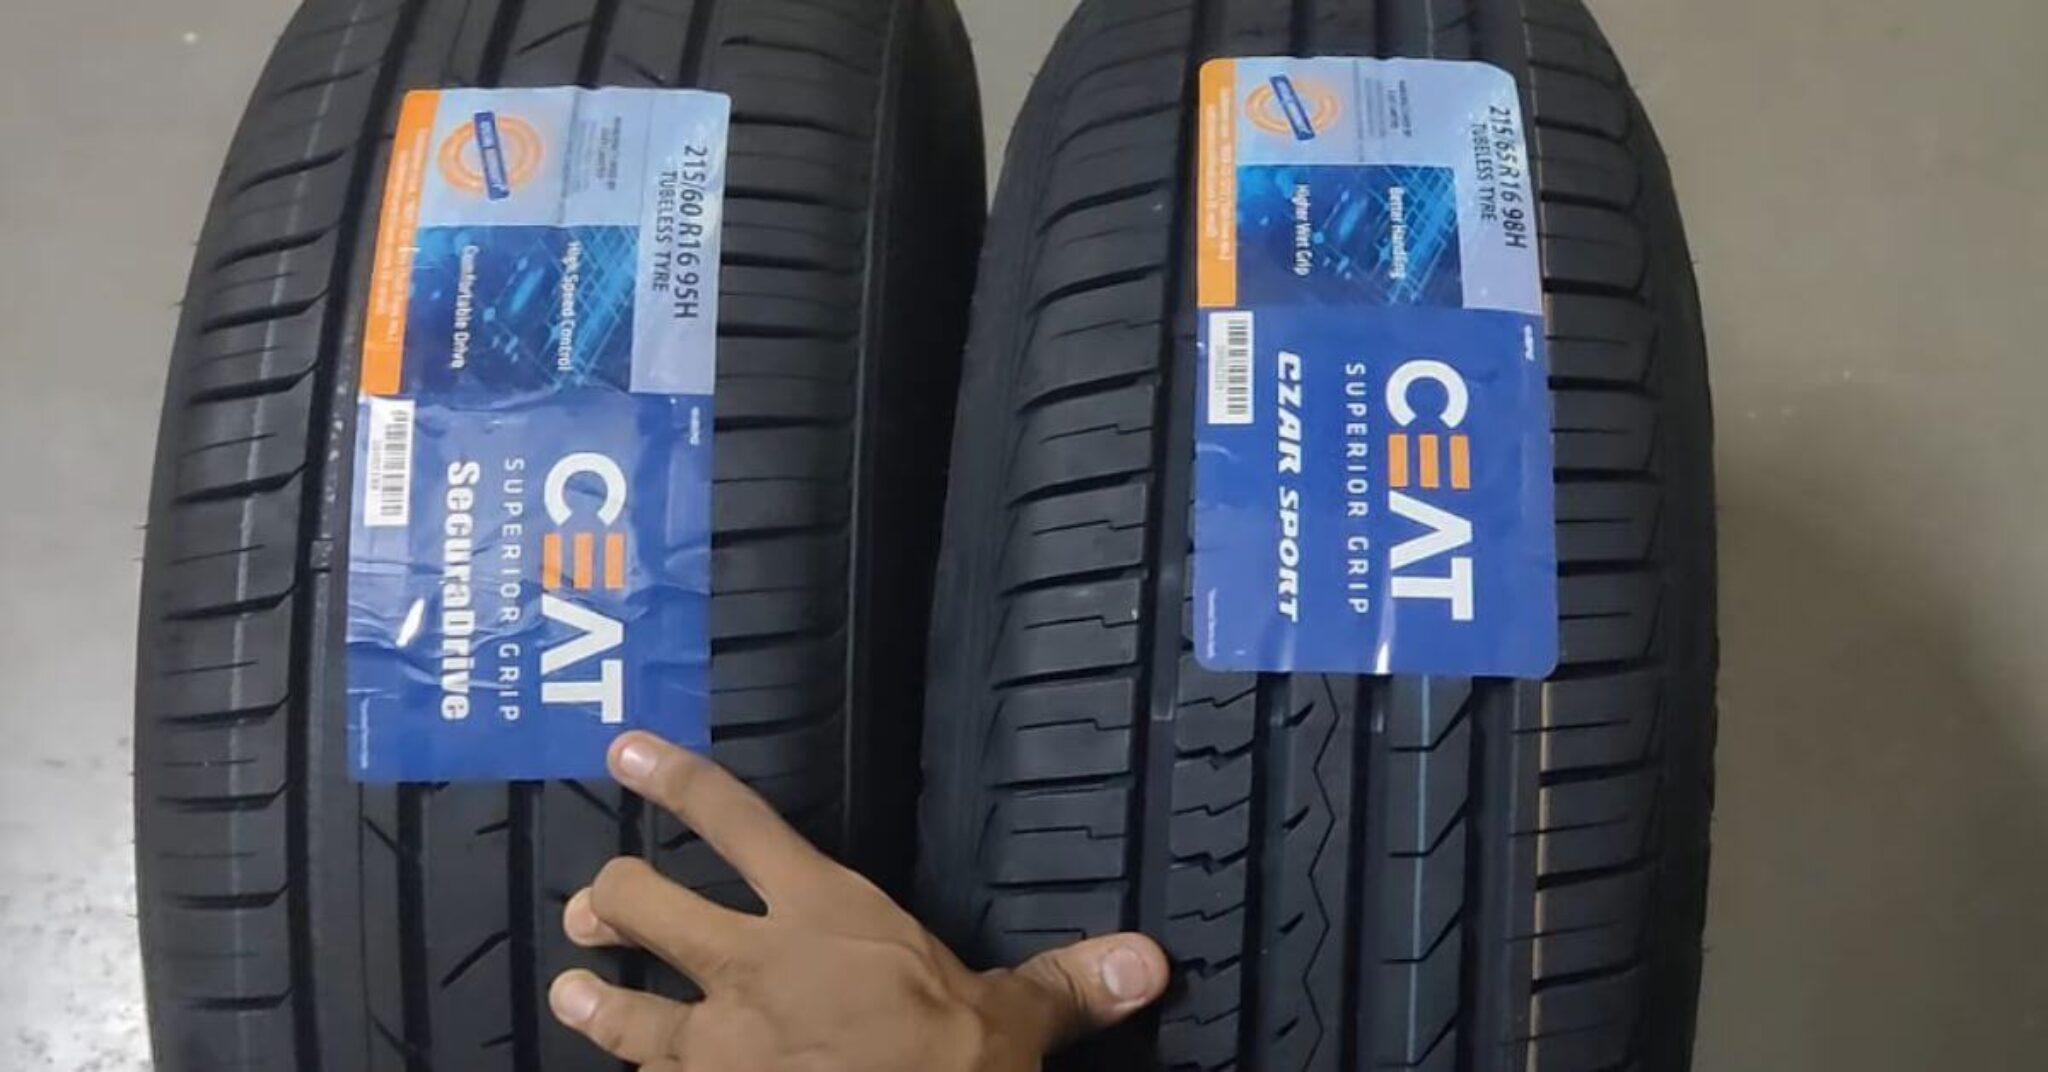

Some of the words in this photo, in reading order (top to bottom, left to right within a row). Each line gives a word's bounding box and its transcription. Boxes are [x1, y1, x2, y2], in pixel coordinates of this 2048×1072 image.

[678, 145, 708, 217] 215/60
[1470, 123, 1493, 182] TUBELESS
[654, 170, 678, 243] TUBELESS
[1290, 184, 1310, 221] Higher
[1477, 186, 1497, 222] TYRE
[1501, 207, 1528, 249] 98H
[560, 240, 581, 273] High
[651, 251, 671, 292] TYRE
[676, 223, 702, 267] R16
[1291, 250, 1313, 276] Grip
[1387, 224, 1407, 280] Handling
[454, 245, 480, 328] Comfortable
[559, 274, 579, 317] Speed
[673, 272, 700, 319] 95H
[448, 331, 470, 370] Drive
[556, 319, 576, 372] Control
[1277, 351, 1301, 475] CZAR
[1345, 363, 1368, 517] SUPERIOR
[1385, 359, 1475, 621] CEAT
[501, 457, 525, 623] SUPERIOR
[1277, 486, 1300, 623] SPORT
[440, 460, 481, 721] SecuraDrive
[540, 451, 627, 724] CEAT
[1347, 536, 1369, 614] GRIP
[499, 642, 521, 721] GRIP
